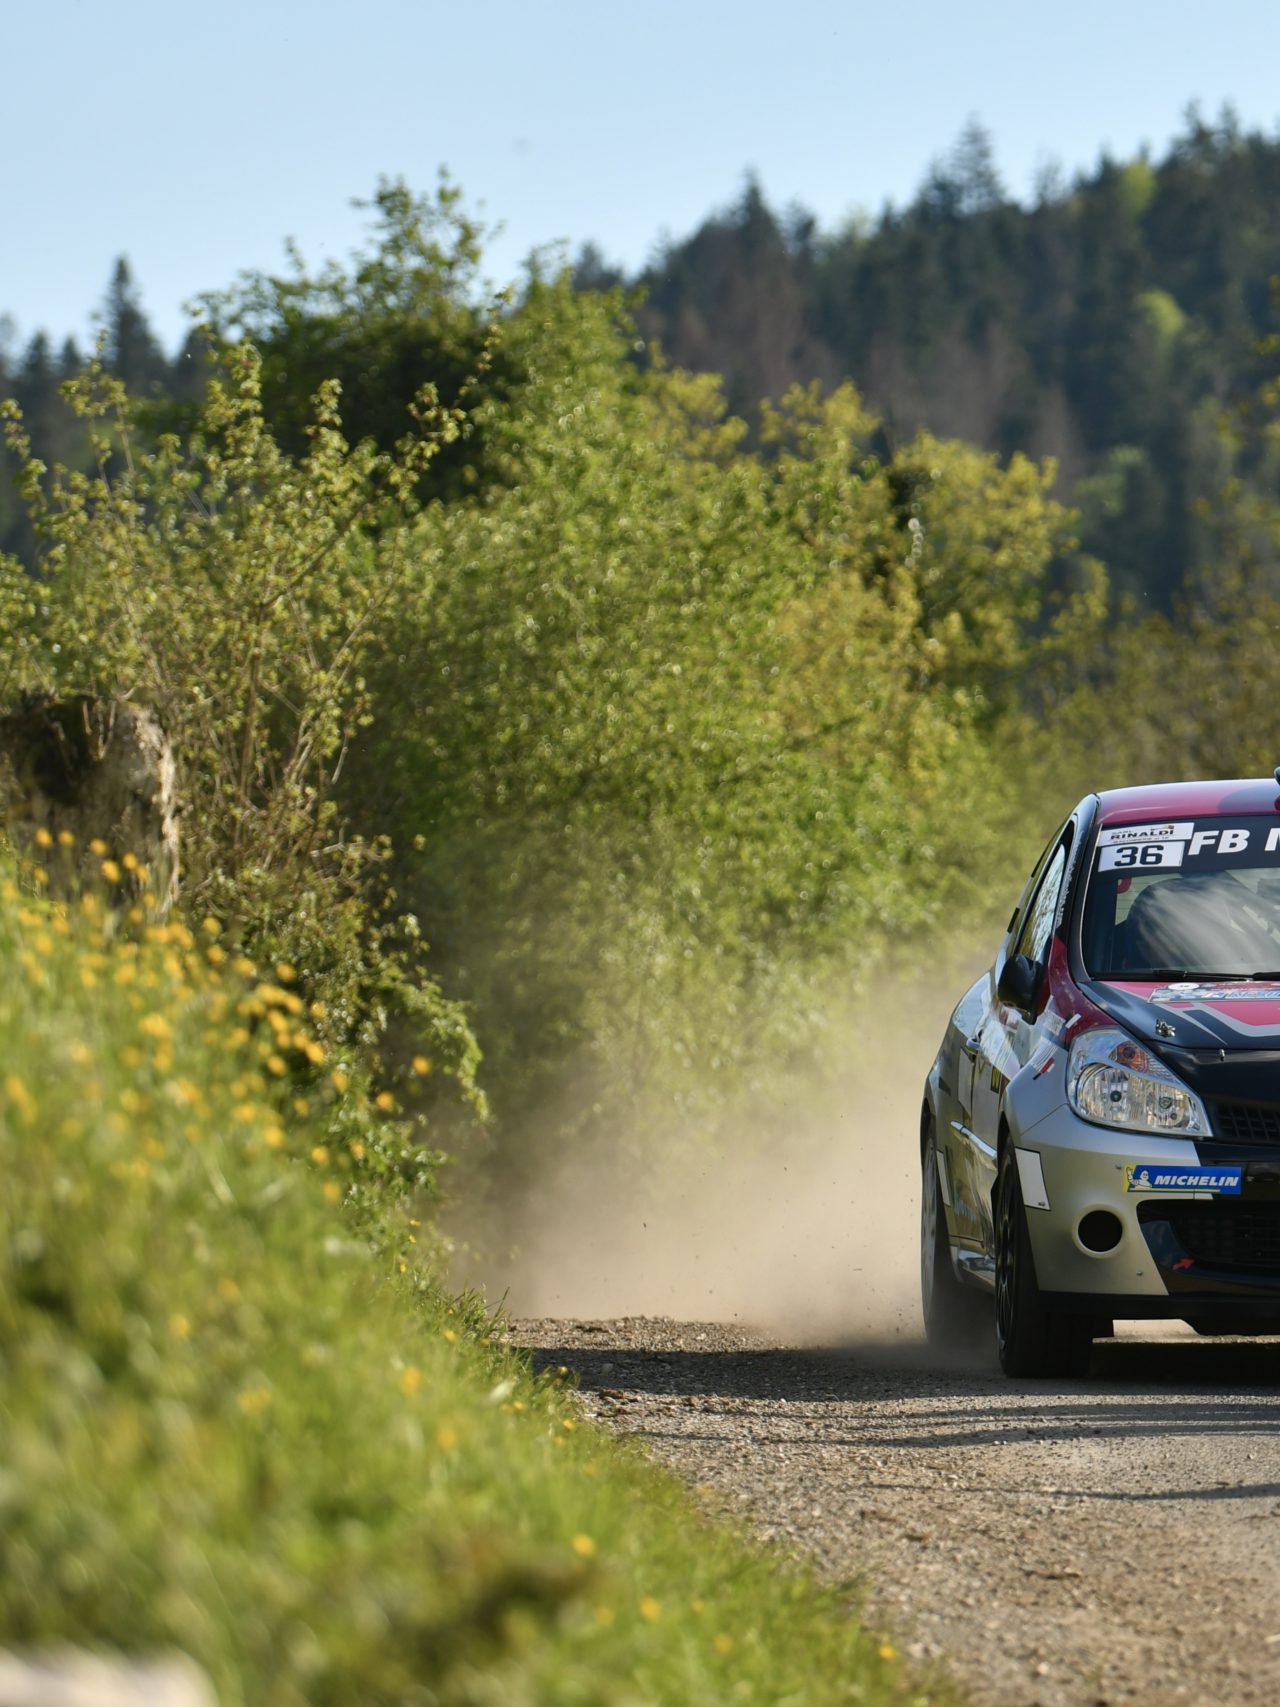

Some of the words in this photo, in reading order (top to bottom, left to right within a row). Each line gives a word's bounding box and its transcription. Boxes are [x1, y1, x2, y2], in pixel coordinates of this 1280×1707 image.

[1111, 829, 1174, 840] RINALDI
[1188, 829, 1250, 855] FB
[1114, 845, 1164, 867] 36
[1154, 1175, 1239, 1187] MICHELIN
